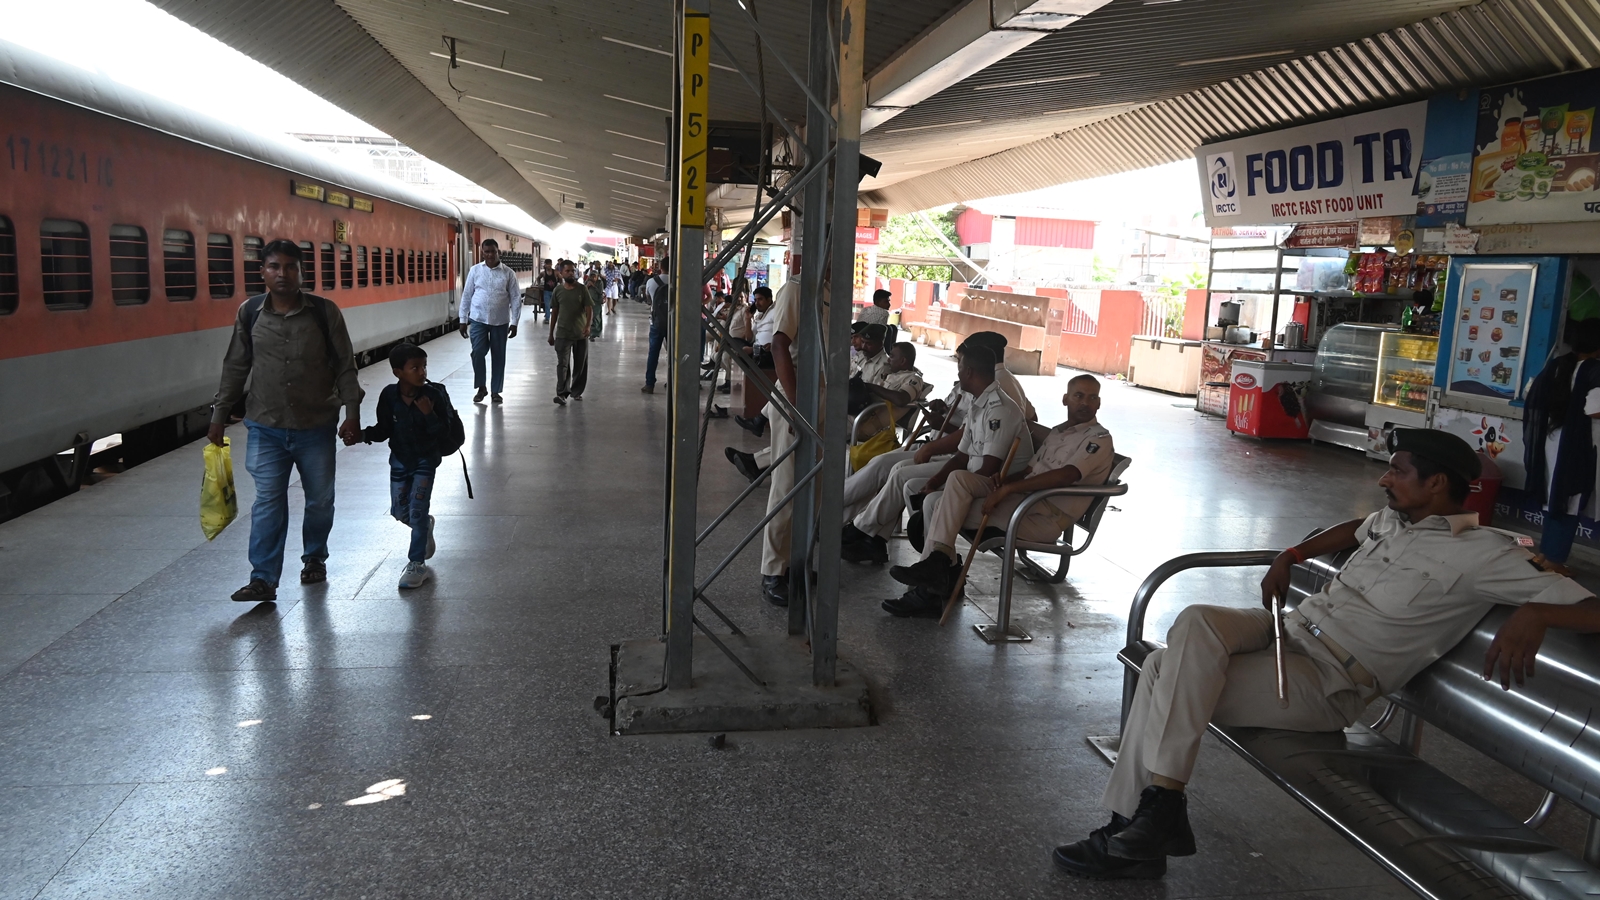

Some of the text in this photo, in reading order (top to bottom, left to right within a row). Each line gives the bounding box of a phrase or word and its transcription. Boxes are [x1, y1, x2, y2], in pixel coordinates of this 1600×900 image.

[1246, 139, 1343, 197] FOOD
[1216, 203, 1236, 213] IRCTC
[1271, 193, 1384, 217] IRCTC FAST FOOD UNIT
